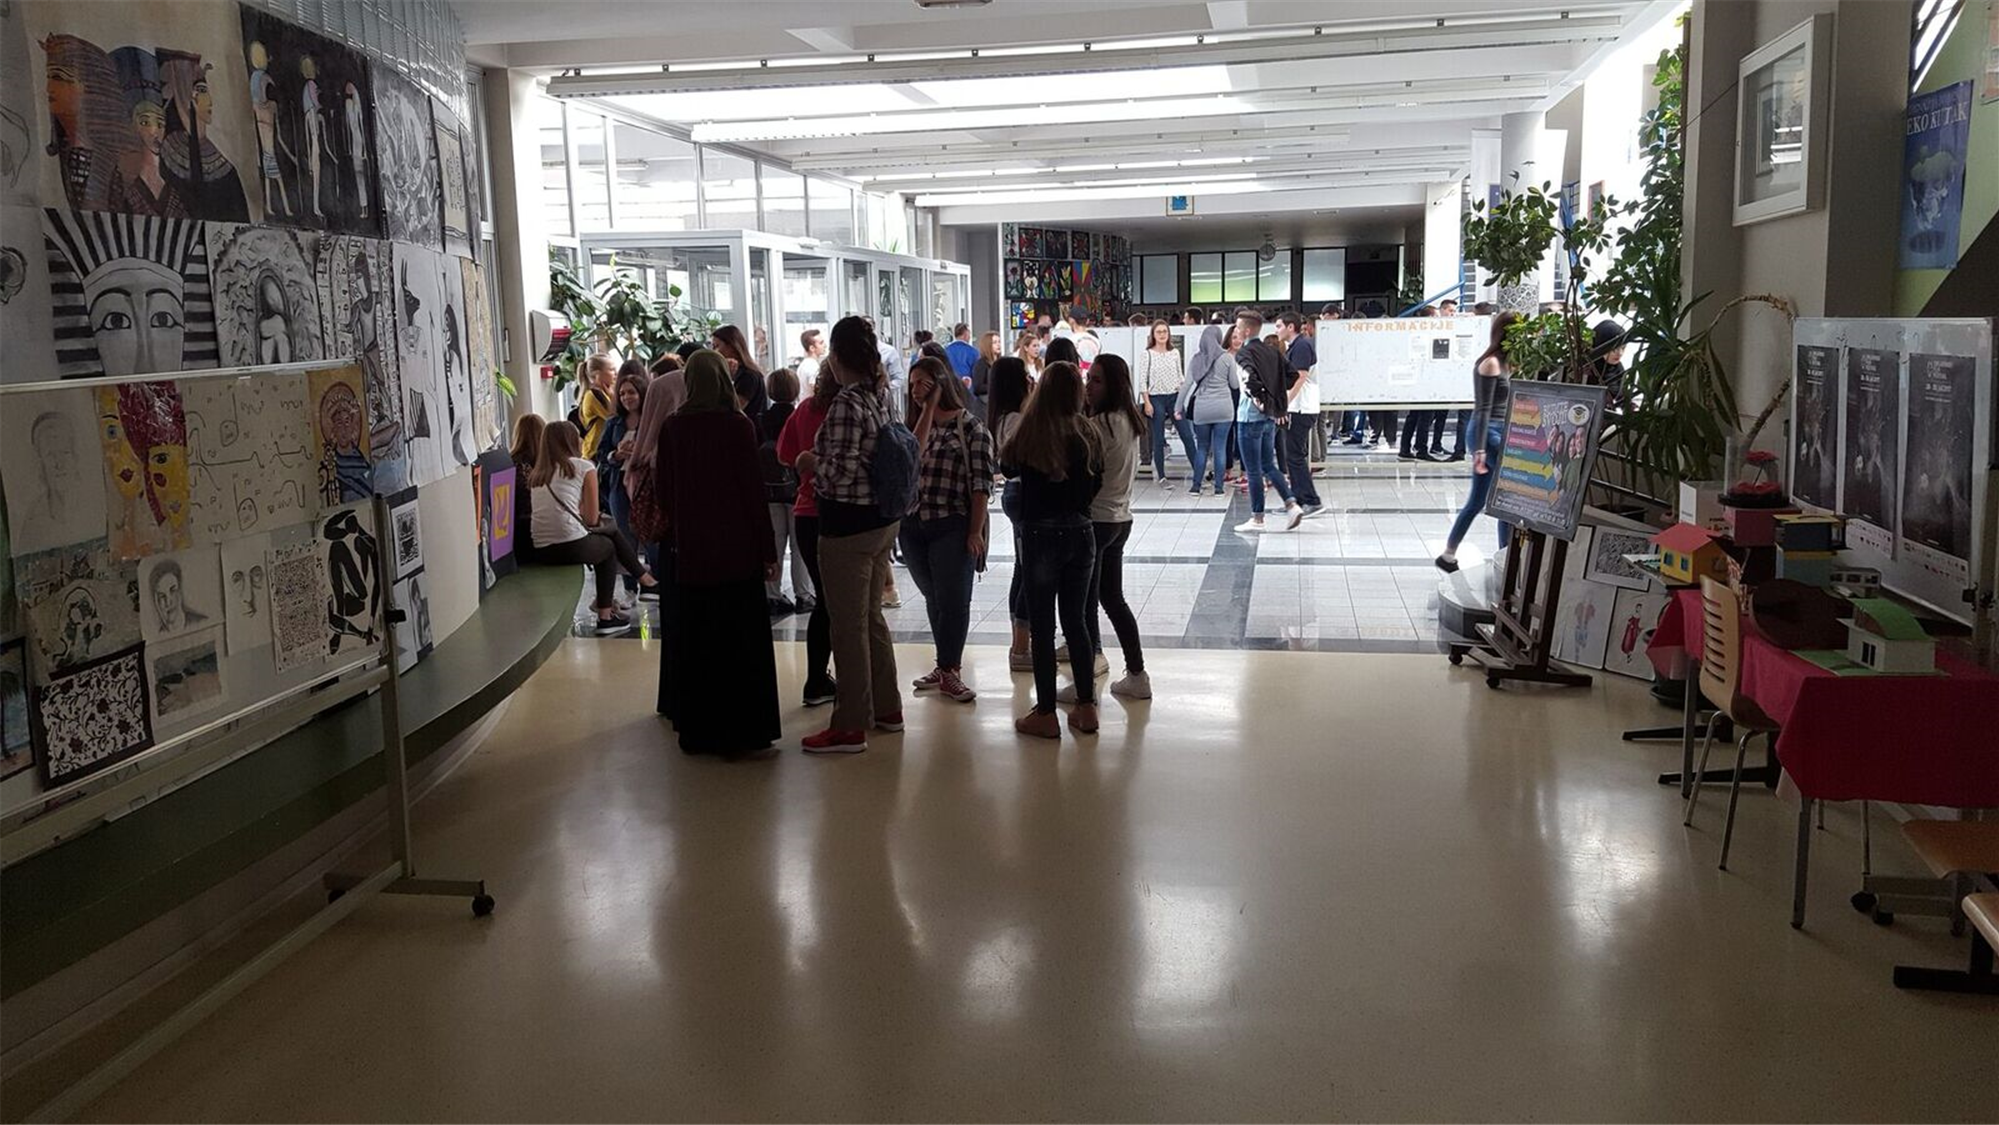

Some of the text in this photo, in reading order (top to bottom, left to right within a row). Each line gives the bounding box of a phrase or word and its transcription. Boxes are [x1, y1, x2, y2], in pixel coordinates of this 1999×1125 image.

[1907, 114, 1928, 134] EKO
[1930, 102, 1969, 128] KUTAK
[1348, 320, 1454, 332] INFORMACIJE
